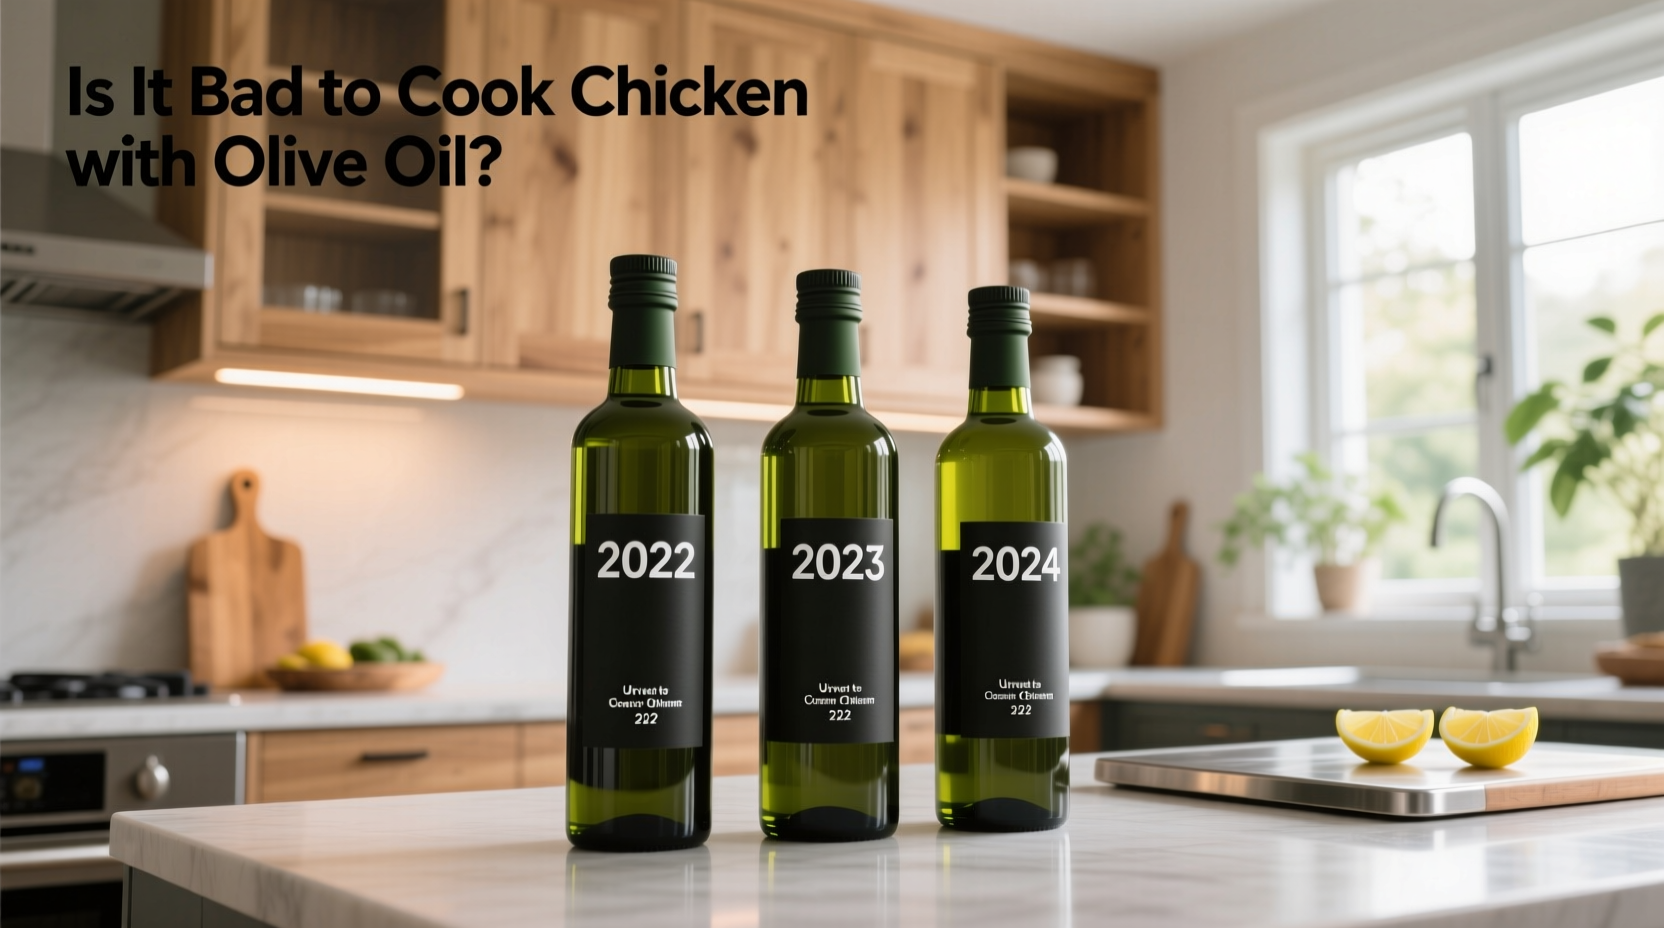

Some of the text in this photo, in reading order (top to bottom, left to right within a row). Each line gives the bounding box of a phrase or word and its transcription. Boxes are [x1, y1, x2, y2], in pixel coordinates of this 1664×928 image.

[597, 540, 696, 579] 2022
[792, 544, 885, 581] 2023
[972, 546, 1060, 582] 2024
[828, 709, 852, 721] 222
